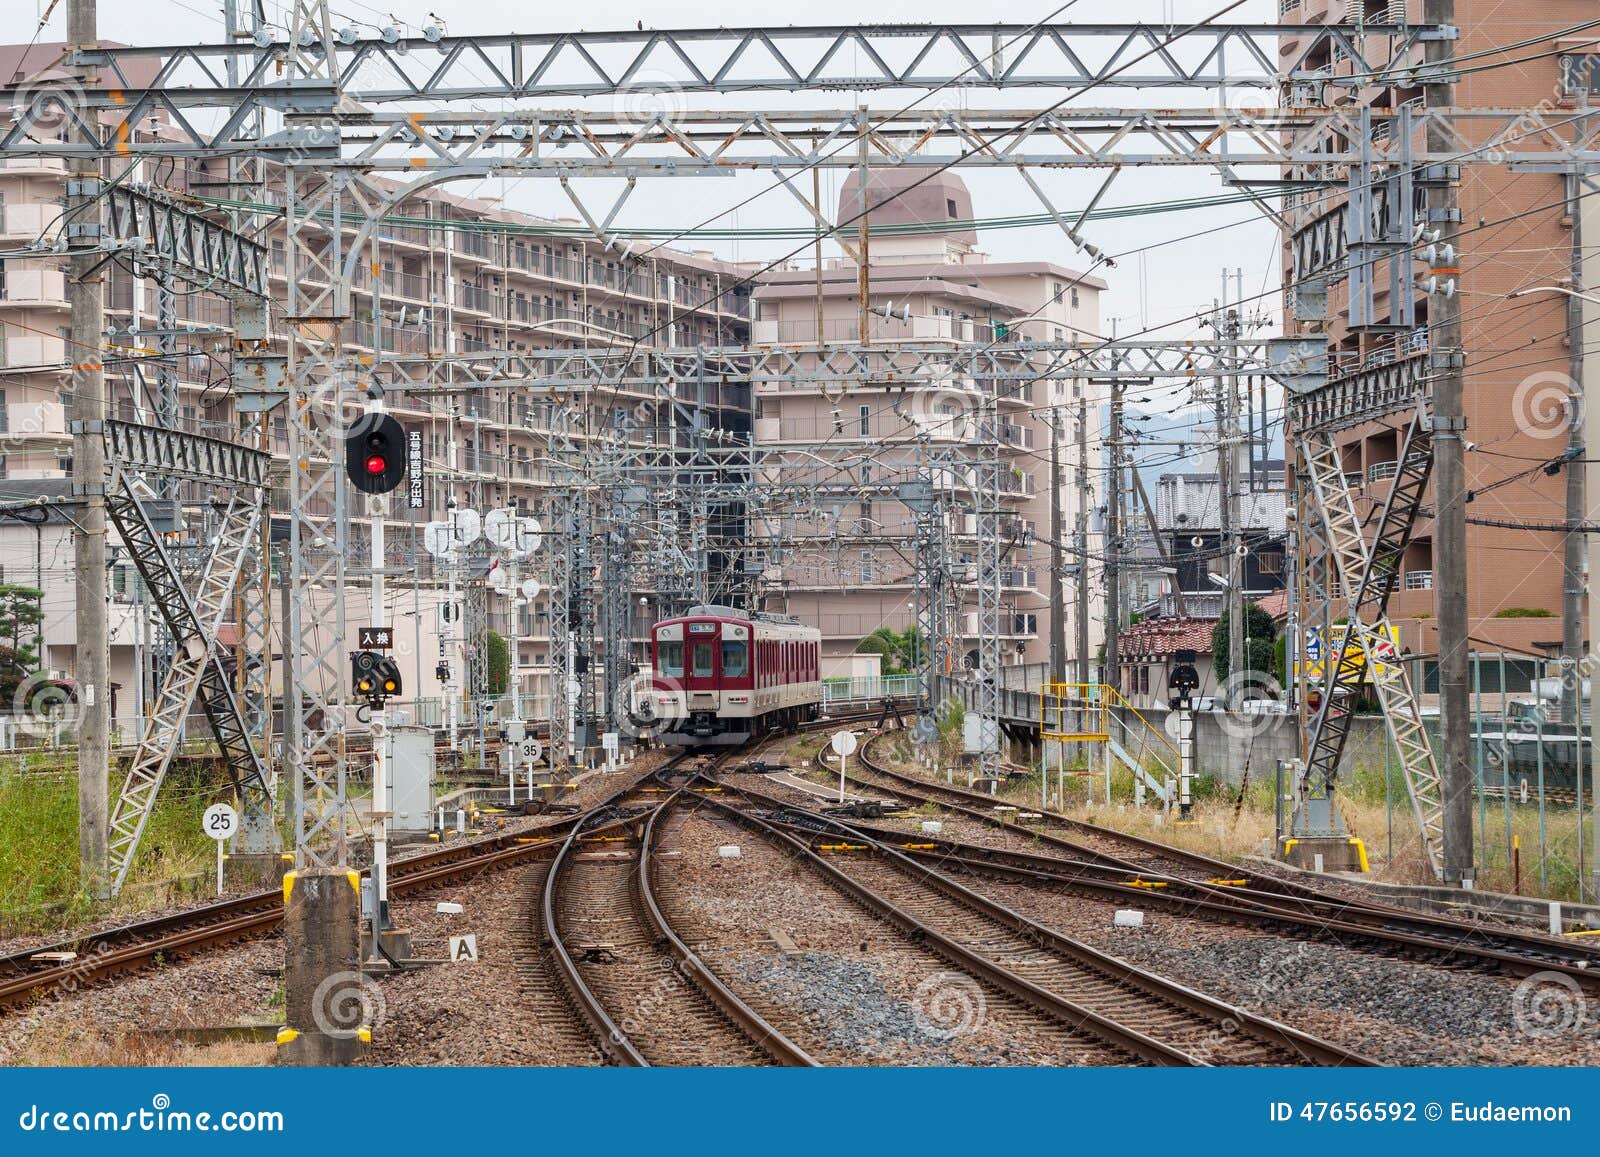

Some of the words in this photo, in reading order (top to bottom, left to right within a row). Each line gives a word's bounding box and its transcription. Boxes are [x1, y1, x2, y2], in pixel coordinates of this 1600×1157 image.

[523, 744, 537, 757] 35
[210, 813, 231, 830] 25
[456, 939, 473, 960] A
